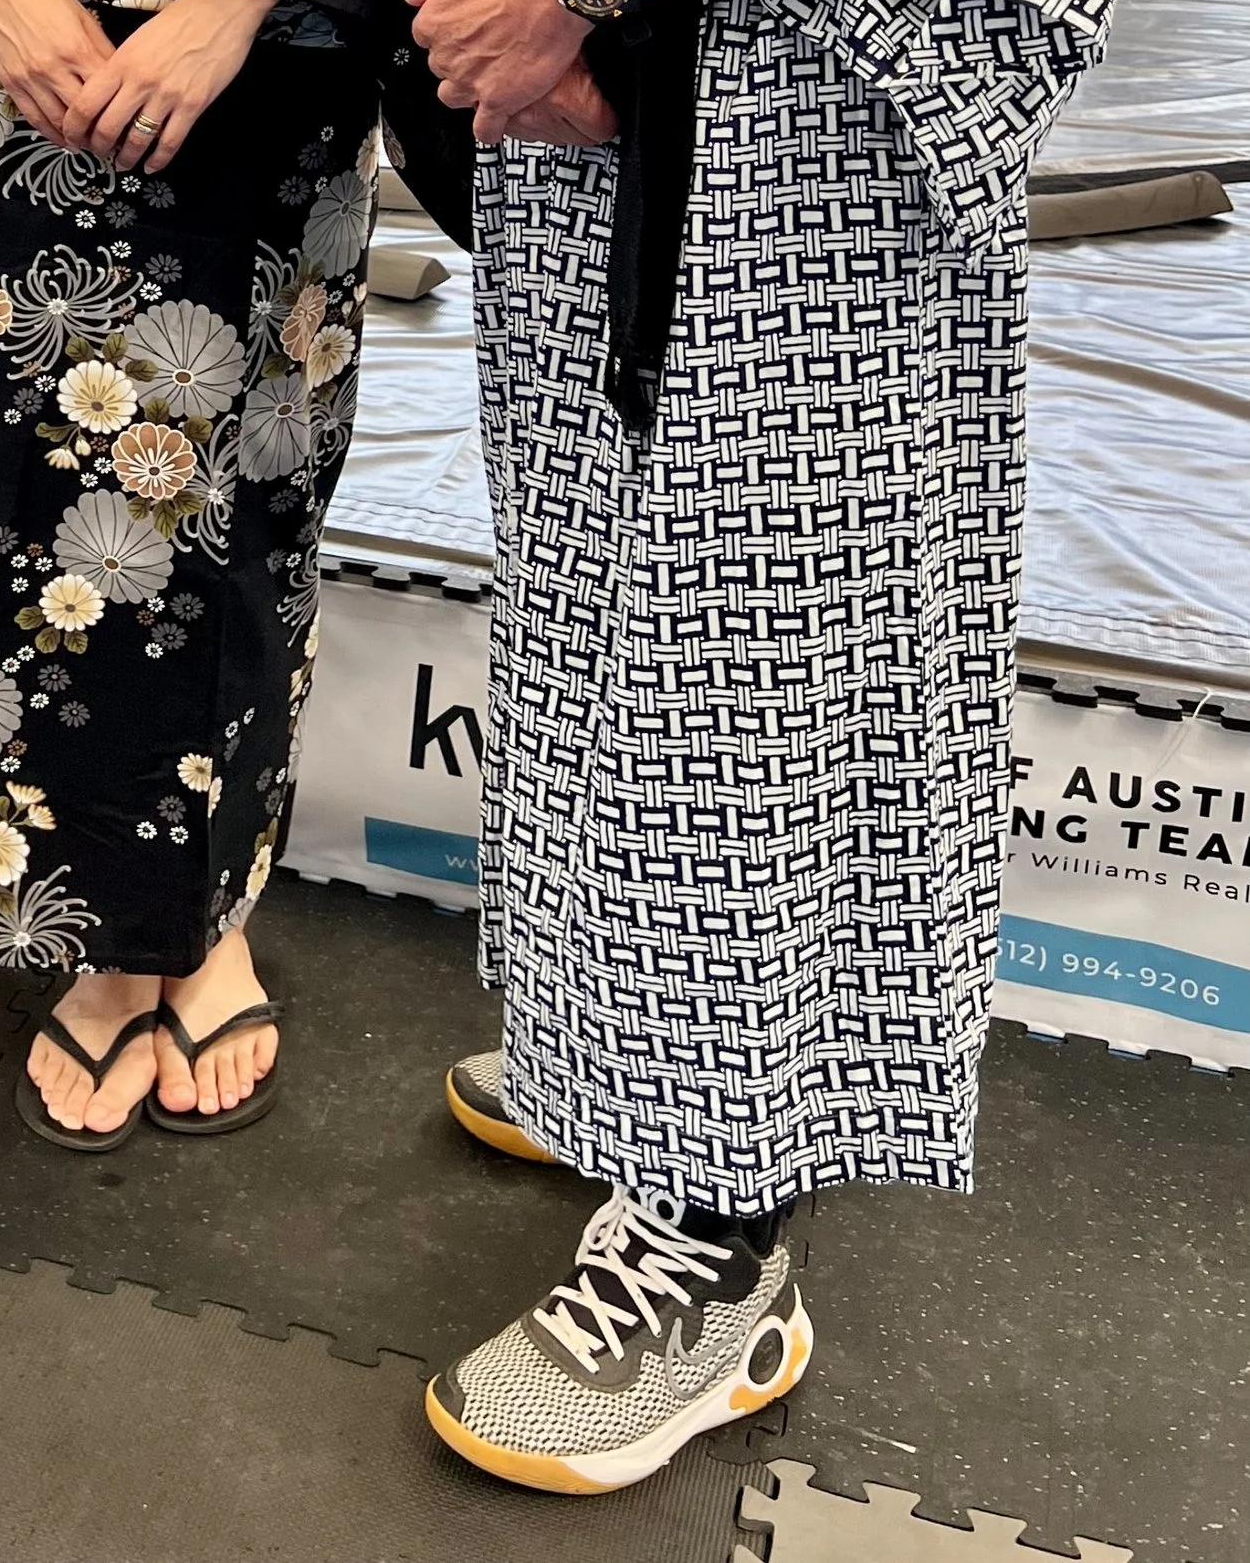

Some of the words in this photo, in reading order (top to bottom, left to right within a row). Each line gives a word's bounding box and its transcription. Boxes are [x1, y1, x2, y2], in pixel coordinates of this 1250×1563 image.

[1010, 756, 1033, 790] F
[1062, 766, 1246, 823] AUSTI
[1011, 806, 1088, 844] NG
[1031, 852, 1168, 886] Williams
[1184, 873, 1250, 903] Real
[1062, 953, 1221, 1006] 994-9206
